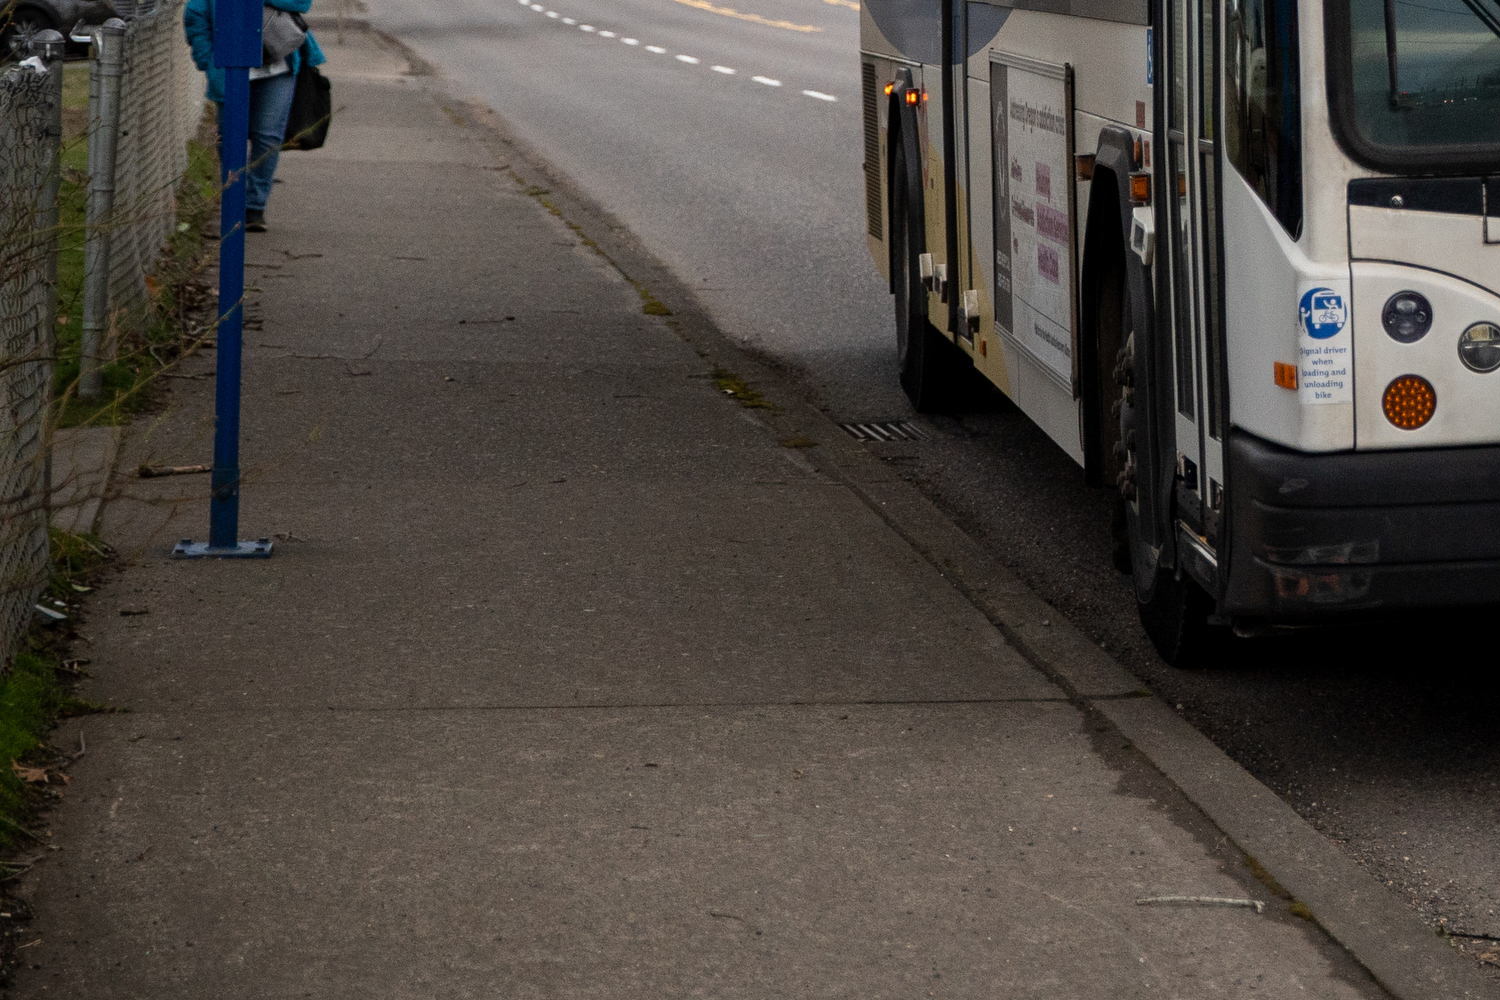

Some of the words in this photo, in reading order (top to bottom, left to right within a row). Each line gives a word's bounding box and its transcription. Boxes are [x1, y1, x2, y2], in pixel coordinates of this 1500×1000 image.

[1300, 347, 1322, 356] Signal
[1302, 369, 1329, 378] loading
[1304, 380, 1344, 389] unloading
